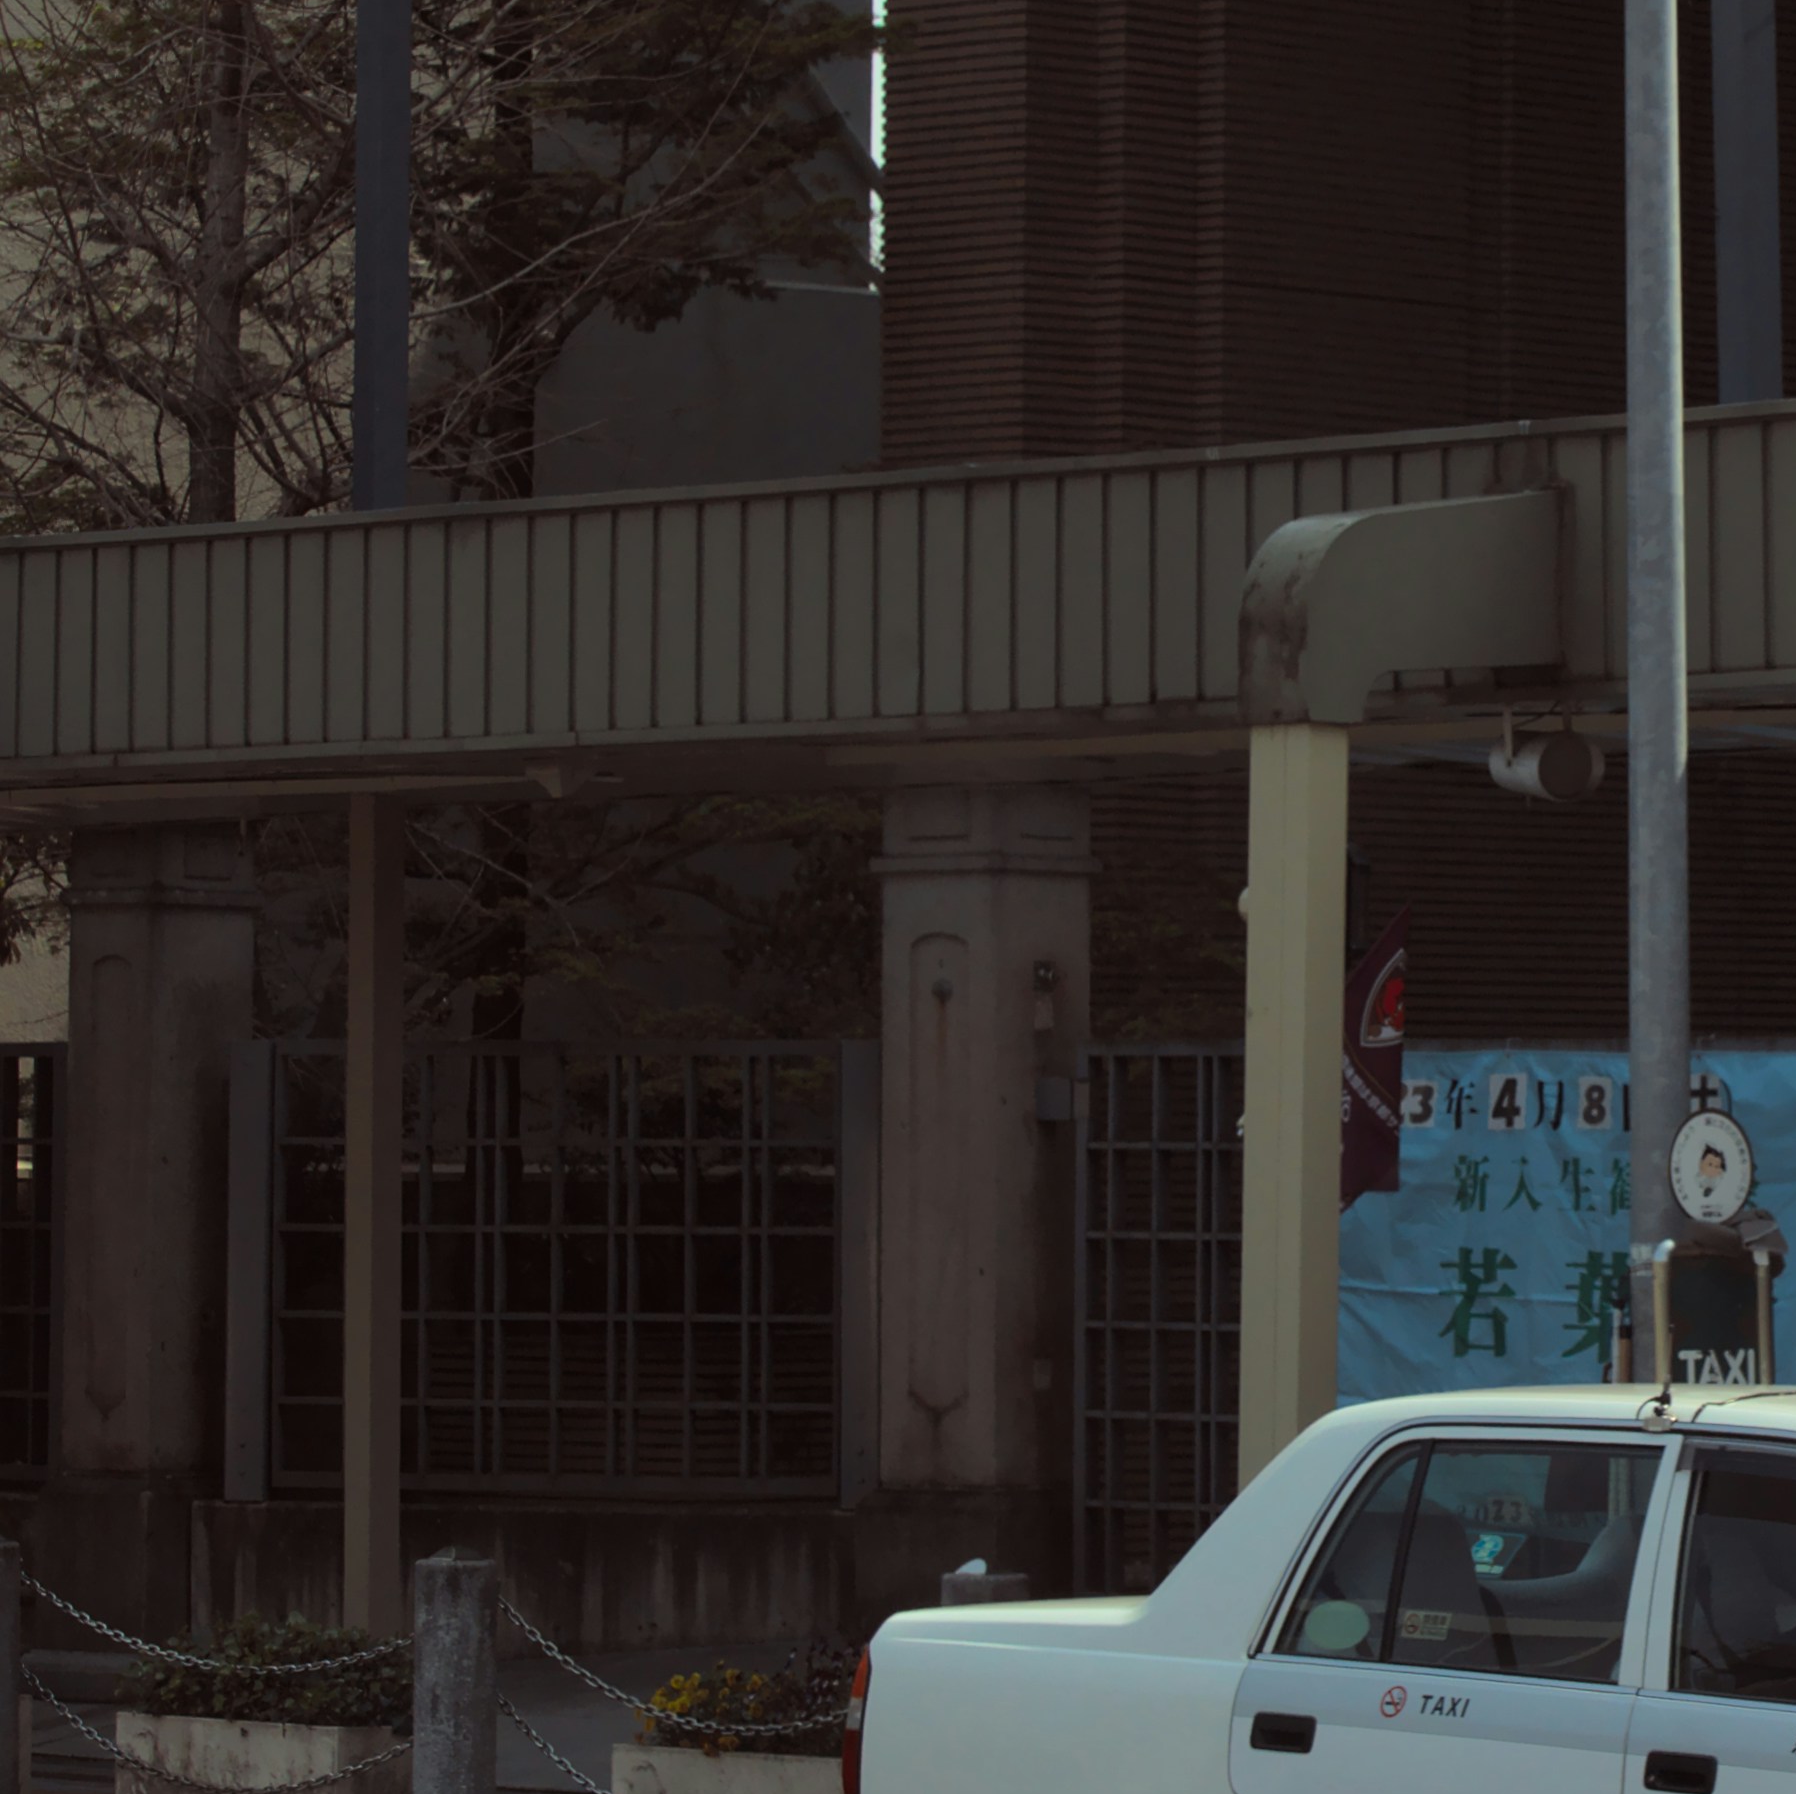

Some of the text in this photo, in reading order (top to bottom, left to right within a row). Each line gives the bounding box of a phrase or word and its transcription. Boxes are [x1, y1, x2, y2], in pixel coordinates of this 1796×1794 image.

[1401, 1075, 1631, 1132] 3年4月8
[1677, 1349, 1756, 1384] TAXI
[1419, 1694, 1471, 1718] TAXI
